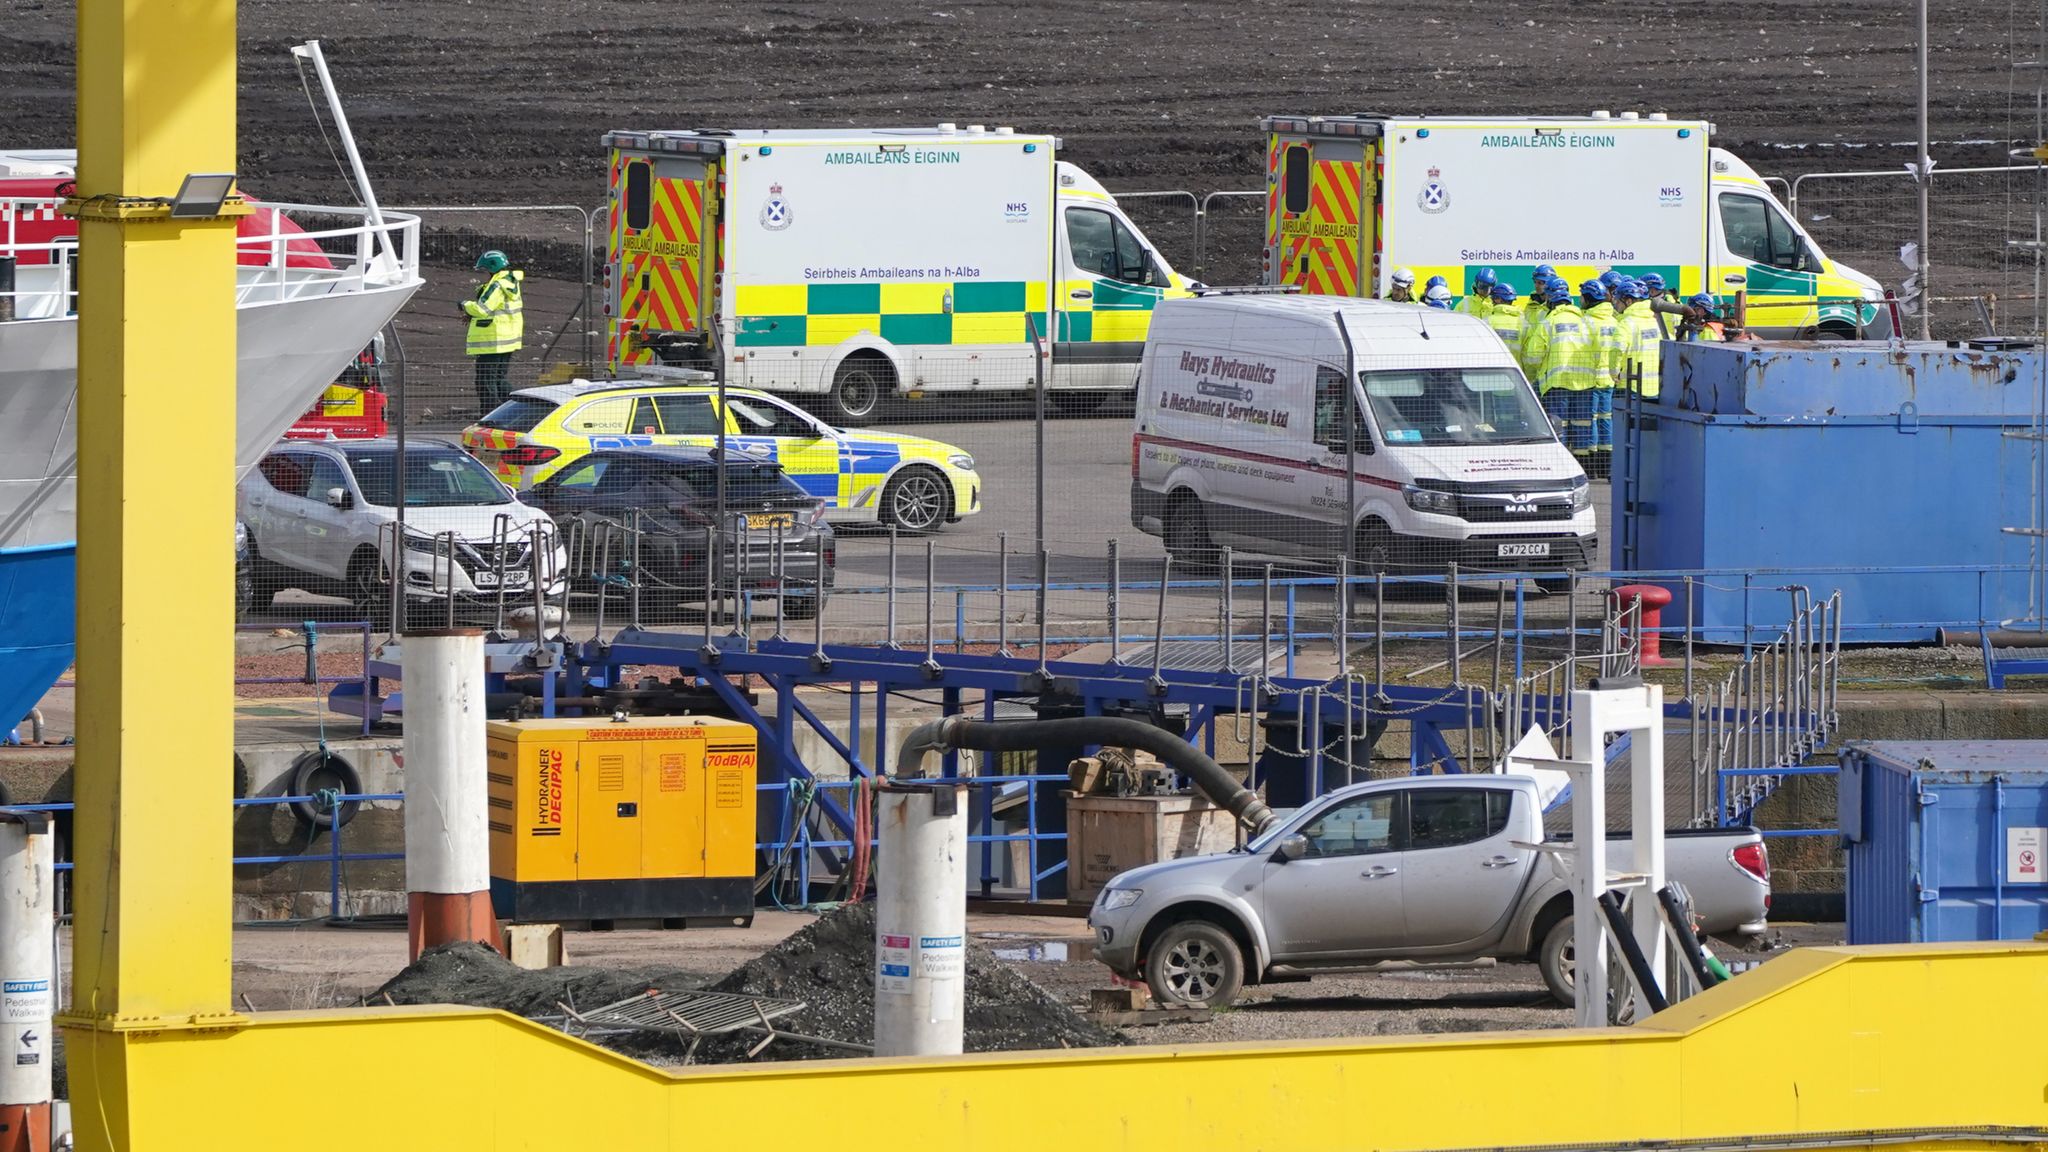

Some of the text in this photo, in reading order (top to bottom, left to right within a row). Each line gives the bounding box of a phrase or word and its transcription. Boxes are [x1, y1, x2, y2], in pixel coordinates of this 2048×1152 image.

[1481, 135, 1566, 148] AMBAILEANS
[824, 151, 910, 165] AMBAILEANS
[1660, 187, 1682, 197] NHS
[1006, 202, 1028, 212] NHS
[1313, 223, 1357, 239] AMBAILEANS
[654, 242, 699, 258] AMBAILEANS
[1461, 249, 1635, 261] Seirbheis Ambaileans na h-Alba
[804, 266, 981, 279] Seirbheis Ambaileans na h-Alba
[1179, 350, 1277, 385] Hays Hydraulics
[1159, 390, 1290, 429] & Mechanical Services Ltd
[1505, 504, 1538, 512] MAN
[1502, 544, 1546, 555] SW72 CCA
[539, 748, 550, 824] HYDRAINER
[550, 750, 562, 824] DECIPAC
[922, 939, 947, 947] SAFETY
[5, 983, 33, 992] SAFETY
